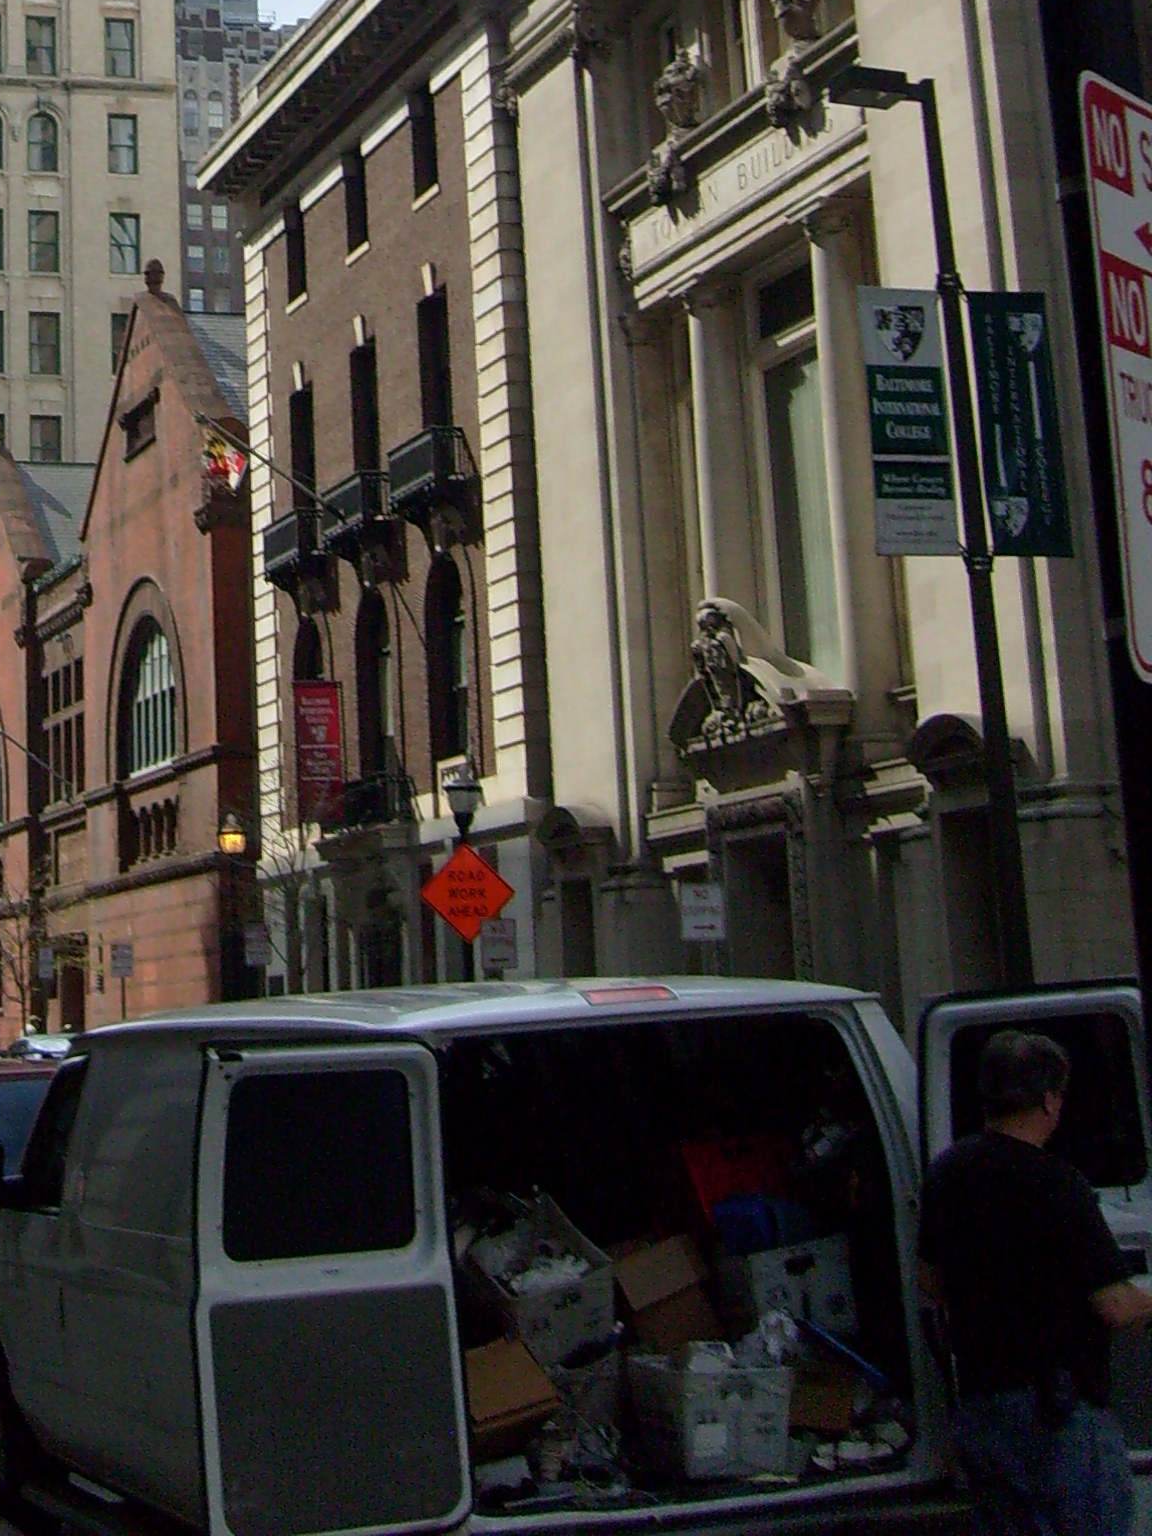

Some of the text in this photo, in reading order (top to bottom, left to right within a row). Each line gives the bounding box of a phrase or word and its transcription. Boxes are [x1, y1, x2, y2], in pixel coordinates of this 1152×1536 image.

[1091, 104, 1128, 179] NO
[1108, 271, 1148, 347] NO
[872, 397, 941, 417] INTERNATIONAL
[885, 420, 932, 440] COLLEGE
[447, 870, 486, 883] ROAD
[447, 888, 487, 900] WORK
[448, 904, 488, 918] AHEAD
